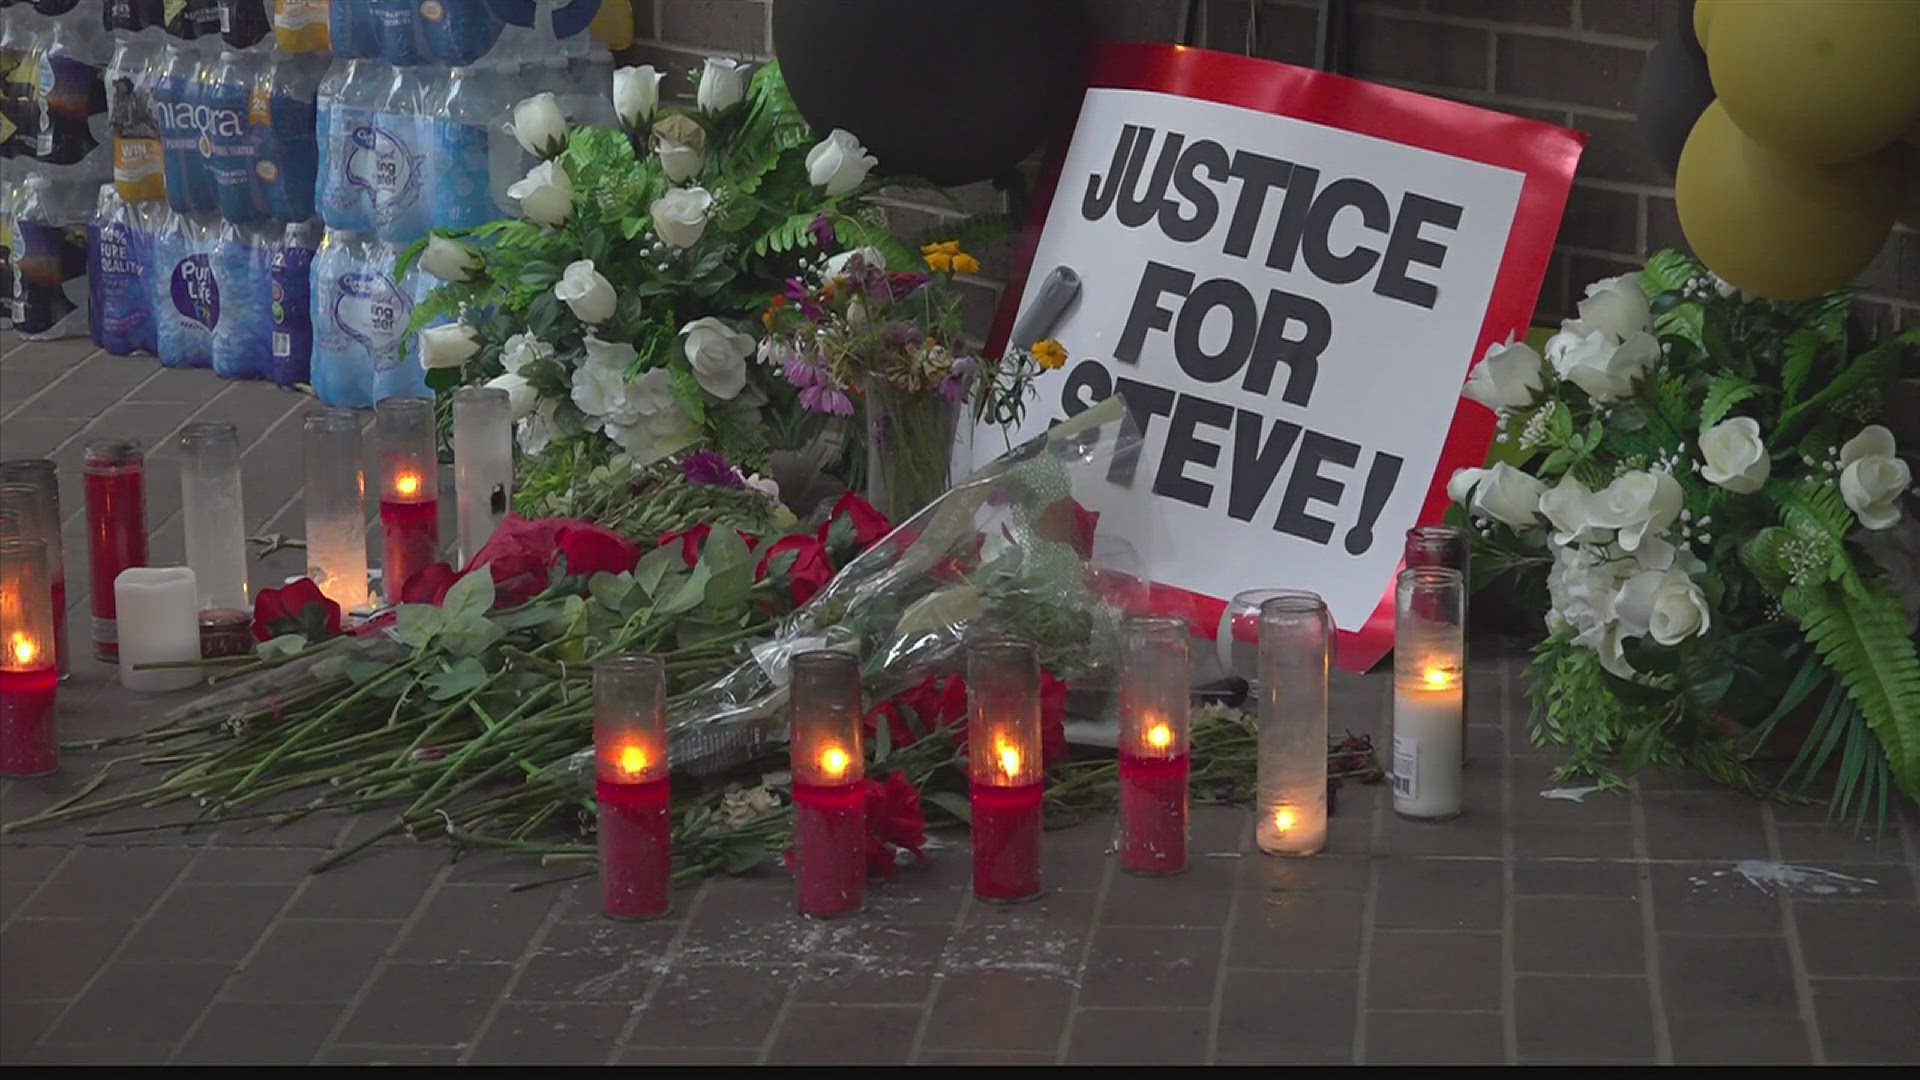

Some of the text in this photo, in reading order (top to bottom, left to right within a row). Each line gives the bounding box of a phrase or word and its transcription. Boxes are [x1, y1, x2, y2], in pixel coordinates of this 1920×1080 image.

[156, 101, 243, 158] niagra
[1081, 123, 1464, 310] JUSTICE
[1113, 260, 1333, 408] FOR
[1047, 359, 1405, 557] STEVE!
